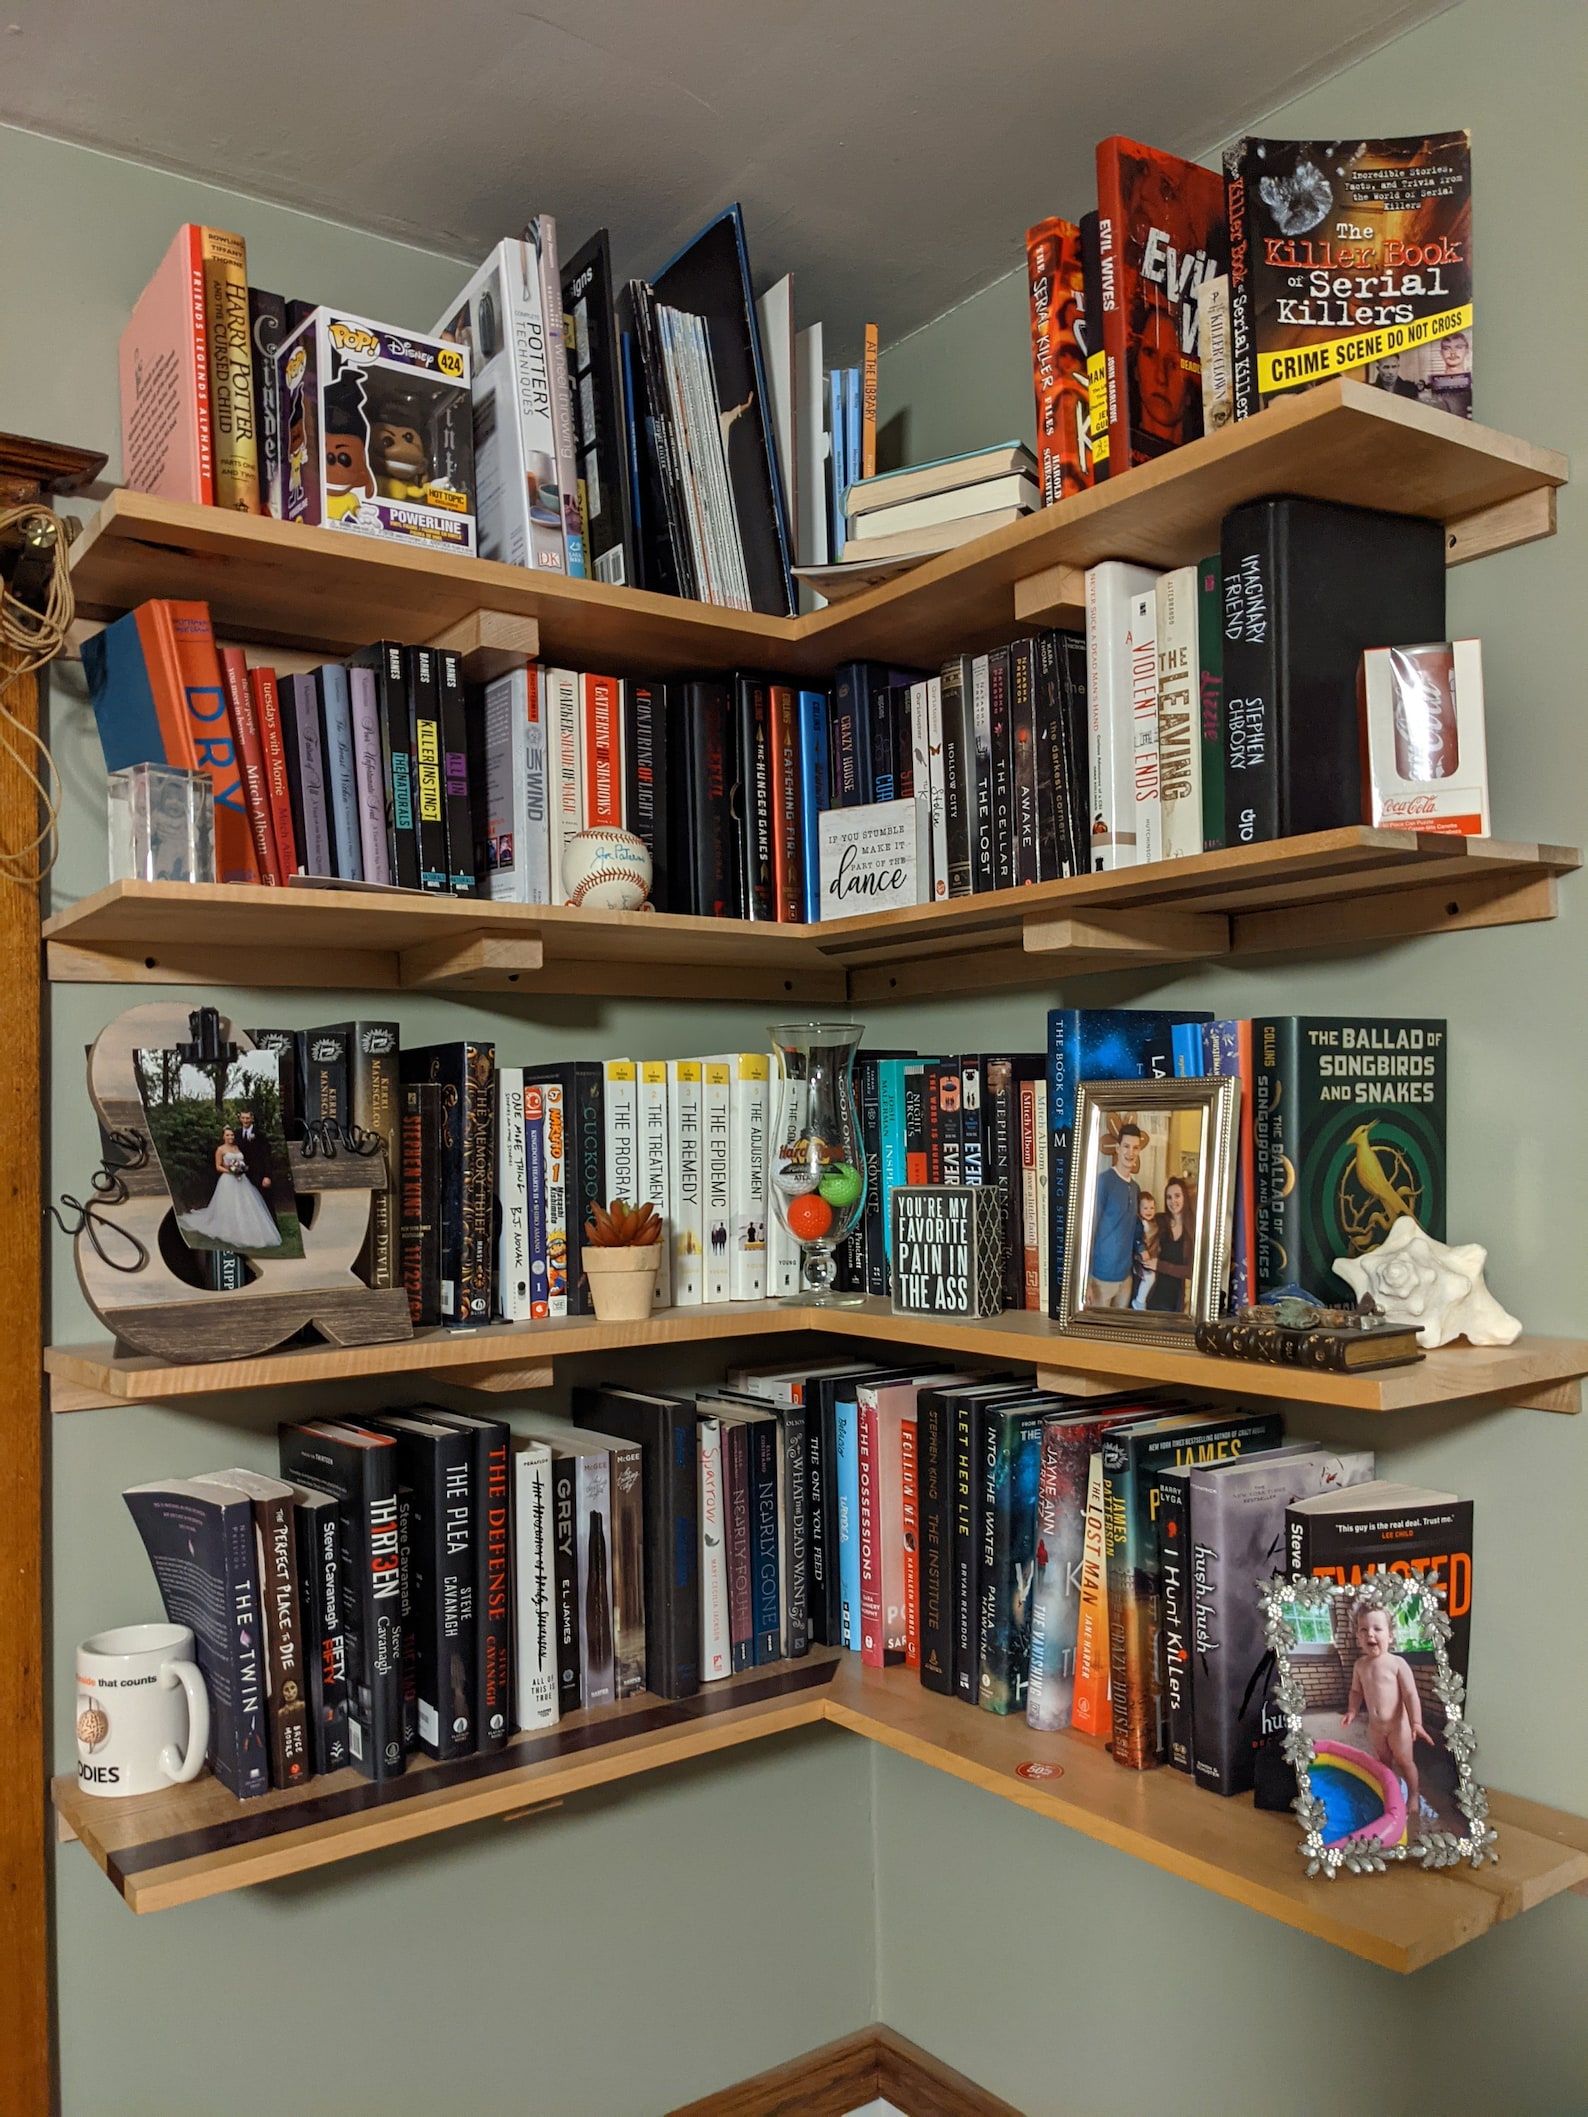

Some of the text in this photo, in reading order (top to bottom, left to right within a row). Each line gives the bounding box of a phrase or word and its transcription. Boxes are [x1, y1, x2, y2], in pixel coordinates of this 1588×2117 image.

[1099, 219, 1116, 312] EVIL WIVES
[1263, 236, 1463, 269] Killer Book
[1336, 223, 1374, 240] The
[1276, 299, 1415, 327] Killers
[1287, 268, 1449, 298] of Serial
[193, 271, 210, 478] FRIENDS LEGENDS ALPHABET
[226, 281, 254, 443] HARRY POTTER
[385, 335, 434, 367] Disney
[441, 354, 461, 374] 424
[514, 321, 533, 416] TECHNIQUES
[526, 322, 550, 420] POTTERY
[1034, 244, 1054, 436] THE SERIAL KILLER FILES
[1272, 312, 1463, 382] CRIME SCENE DO NOT CROSS
[865, 340, 876, 423] AT THE LIBRARY
[390, 509, 462, 534] POWERLINE
[1224, 554, 1267, 644] IMAGINARY FRIEND
[389, 648, 400, 680] BARNES
[419, 652, 430, 684] BARNES
[445, 657, 457, 688] BARNES
[1126, 631, 1159, 802] A VIOLENT ENDS
[1158, 646, 1192, 802] THE LEAVING
[1200, 670, 1223, 747] Lizzie
[1228, 697, 1265, 770] STEPHEN CHBOSKY
[393, 753, 411, 827] THE NATURALS
[420, 720, 438, 820] KILLER INSTINCT
[784, 749, 796, 859] CATCHING FIRE
[948, 742, 958, 818] HOLLOW CITY
[829, 825, 904, 844] IF YOU STUMBLE
[862, 842, 905, 855] MAKE IT
[978, 777, 990, 874] THE LOST
[997, 760, 1008, 875] THE CELLAR
[1021, 786, 1031, 847] AWAKE
[829, 844, 907, 900] dance
[851, 857, 906, 871] PART OF THE
[1055, 1054, 1064, 1091] BOOK
[1264, 1026, 1275, 1068] COLLINS
[1308, 1028, 1442, 1050] THE BALLAD OF
[1319, 1055, 1435, 1076] SONGBIRDS
[372, 1060, 388, 1128] KERRI MANISCALCO
[1023, 1094, 1033, 1164] Mitch Albom
[1056, 1098, 1064, 1116] OF
[1320, 1083, 1434, 1104] AND SNAKES
[474, 1089, 488, 1233] THE MEMORY THIEF
[512, 1093, 525, 1194] ONE MORE THING
[548, 1108, 563, 1182] NARUTO 1
[648, 1104, 664, 1208] THE TREATMENT
[681, 1102, 698, 1205] THE REMEDY
[710, 1105, 726, 1207] THE EPIDEMIC
[1054, 1132, 1066, 1148] M
[1271, 1115, 1284, 1235] THE BALLAD OF
[898, 1197, 968, 1219] YOU'RE MY
[1258, 1075, 1269, 1279] SONGBIRDS AND SNAKES
[374, 1200, 389, 1286] THE DEVIL
[899, 1219, 968, 1244] FAVORITE
[899, 1244, 968, 1276] PAIN IN
[899, 1275, 968, 1310] THE ASS
[617, 1453, 641, 1464] McGEE
[928, 1410, 937, 1499] STEPHEN KING
[958, 1410, 969, 1537] LET HER LIE
[1160, 1484, 1182, 1494] BARRY
[446, 1462, 468, 1555] THE PLEA
[488, 1445, 506, 1622] THE DEFENSE
[557, 1478, 573, 1557] GREY
[811, 1437, 823, 1581] THE ONE YOU FEED
[860, 1423, 871, 1580] THE POSSESSIONS
[1104, 1479, 1127, 1557] JAMES PATTERSON
[1160, 1493, 1182, 1505] LYGA
[1381, 1529, 1414, 1540] LEE CHILD
[323, 1522, 337, 1631] Steve Cavanagh
[759, 1481, 776, 1625] NEARLY GONE
[928, 1514, 939, 1630] THE INSTITUTE
[1083, 1480, 1104, 1607] THE LOST MAN
[1291, 1523, 1304, 1569] Steve
[391, 1625, 401, 1659] Steve
[444, 1576, 472, 1638] STEVE CAVANAGH
[98, 1678, 118, 1688] that
[120, 1675, 158, 1688] counts
[234, 1580, 257, 1713] THE TWIN
[374, 1615, 389, 1676] Cavanagh
[1081, 1613, 1093, 1679] JANE HARPER
